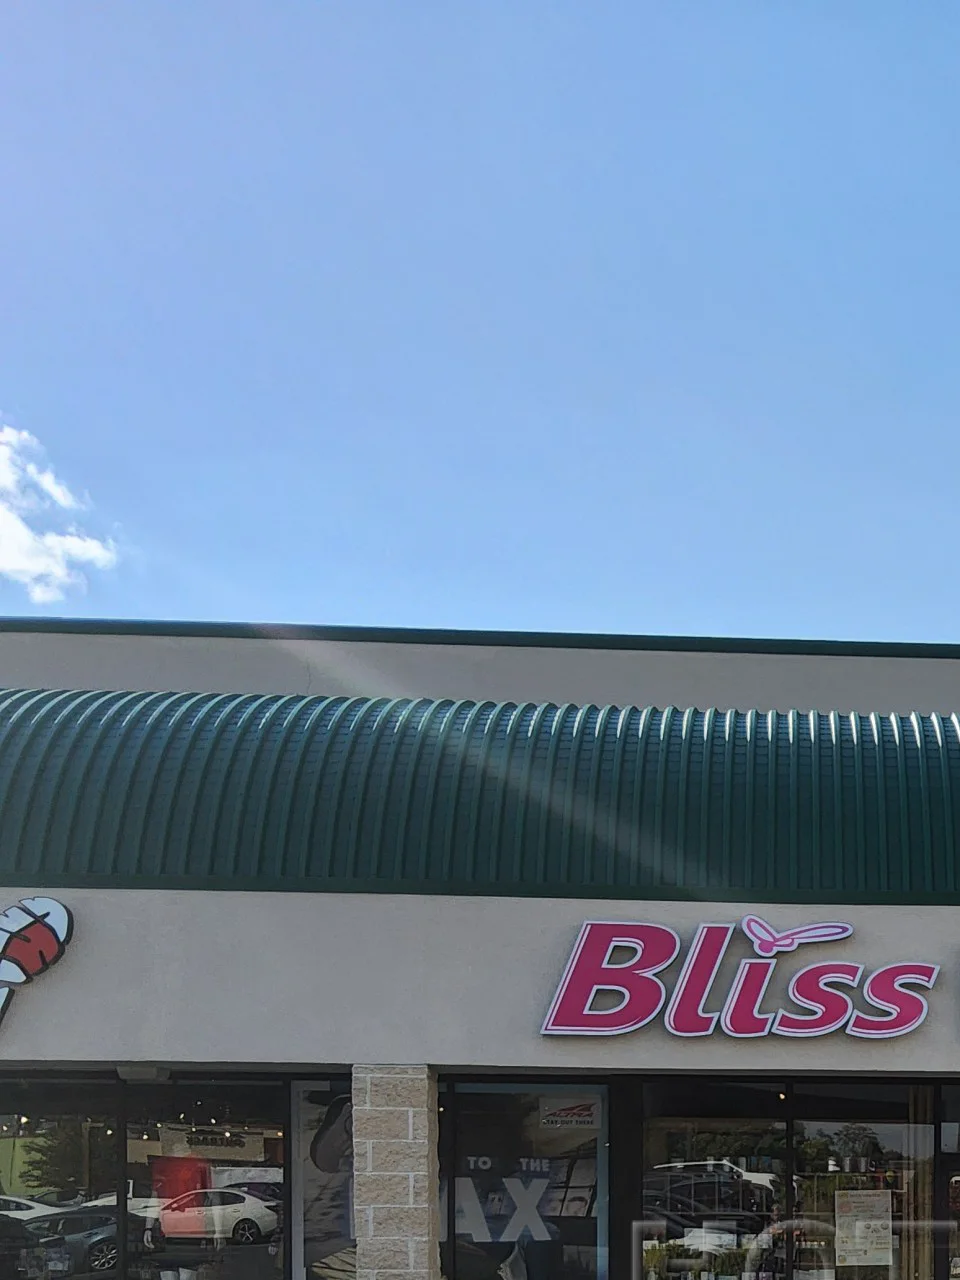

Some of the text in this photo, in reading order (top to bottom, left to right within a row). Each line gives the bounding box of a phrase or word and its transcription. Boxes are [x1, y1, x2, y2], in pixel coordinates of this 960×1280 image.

[540, 916, 941, 1039] Bliss
[467, 1156, 550, 1172] TO THE
[438, 1176, 552, 1243] AX
